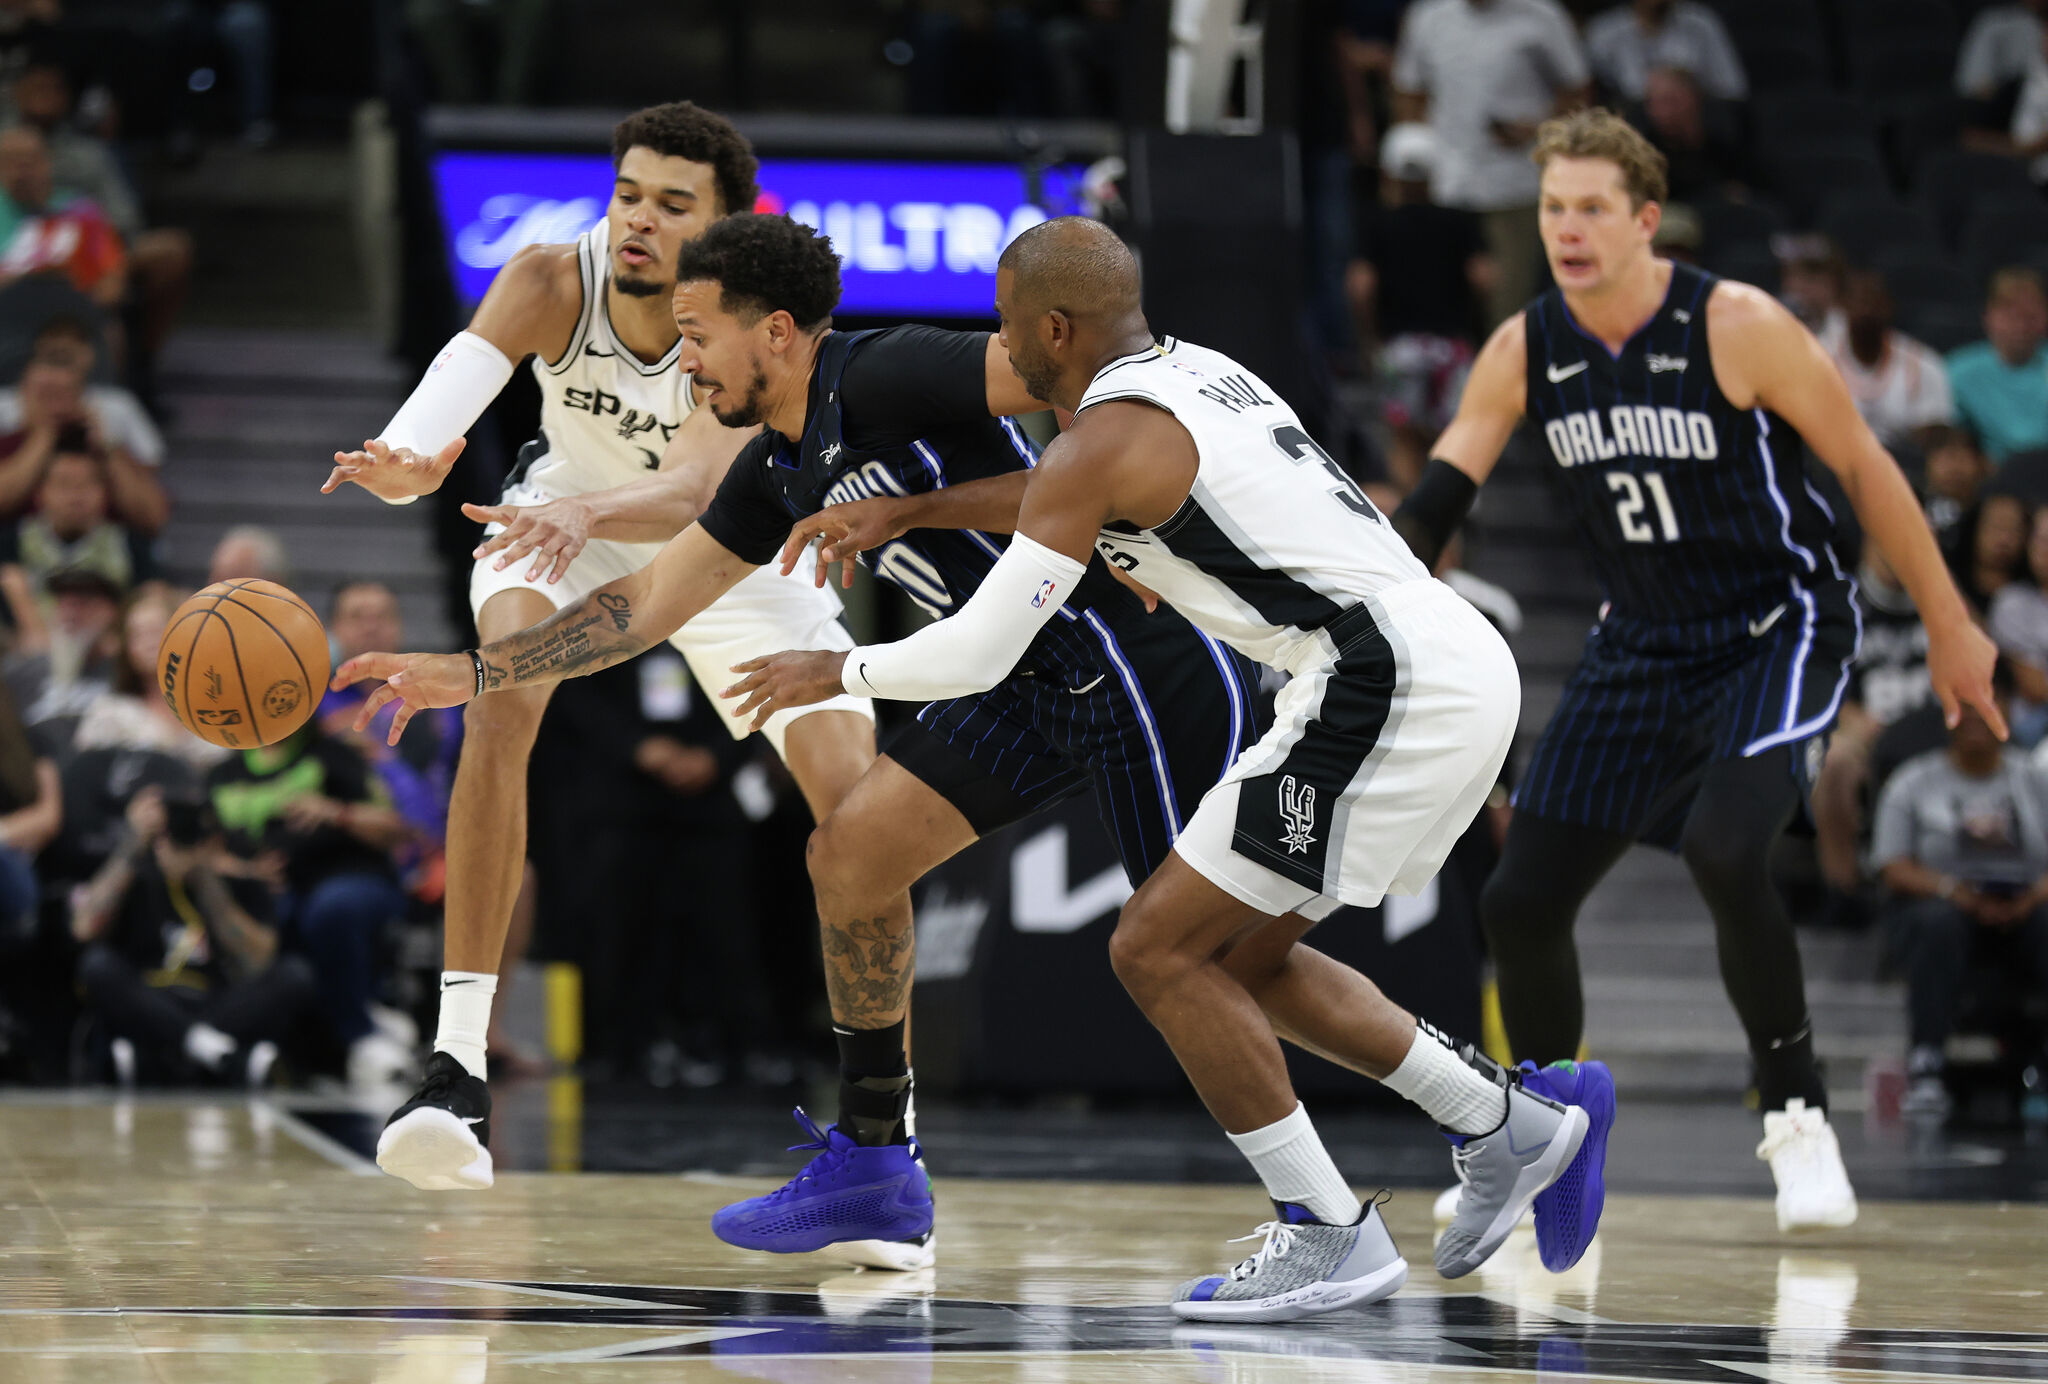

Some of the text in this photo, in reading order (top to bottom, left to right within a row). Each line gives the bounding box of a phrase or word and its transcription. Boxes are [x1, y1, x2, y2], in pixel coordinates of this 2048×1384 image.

[563, 386, 681, 443] SPU
[1198, 374, 1274, 413] PAUL
[1545, 405, 1718, 468] ORLANDO
[1266, 421, 1386, 530] 3
[1605, 472, 1680, 542] 21
[544, 633, 559, 648] and
[597, 593, 632, 632] Ella
